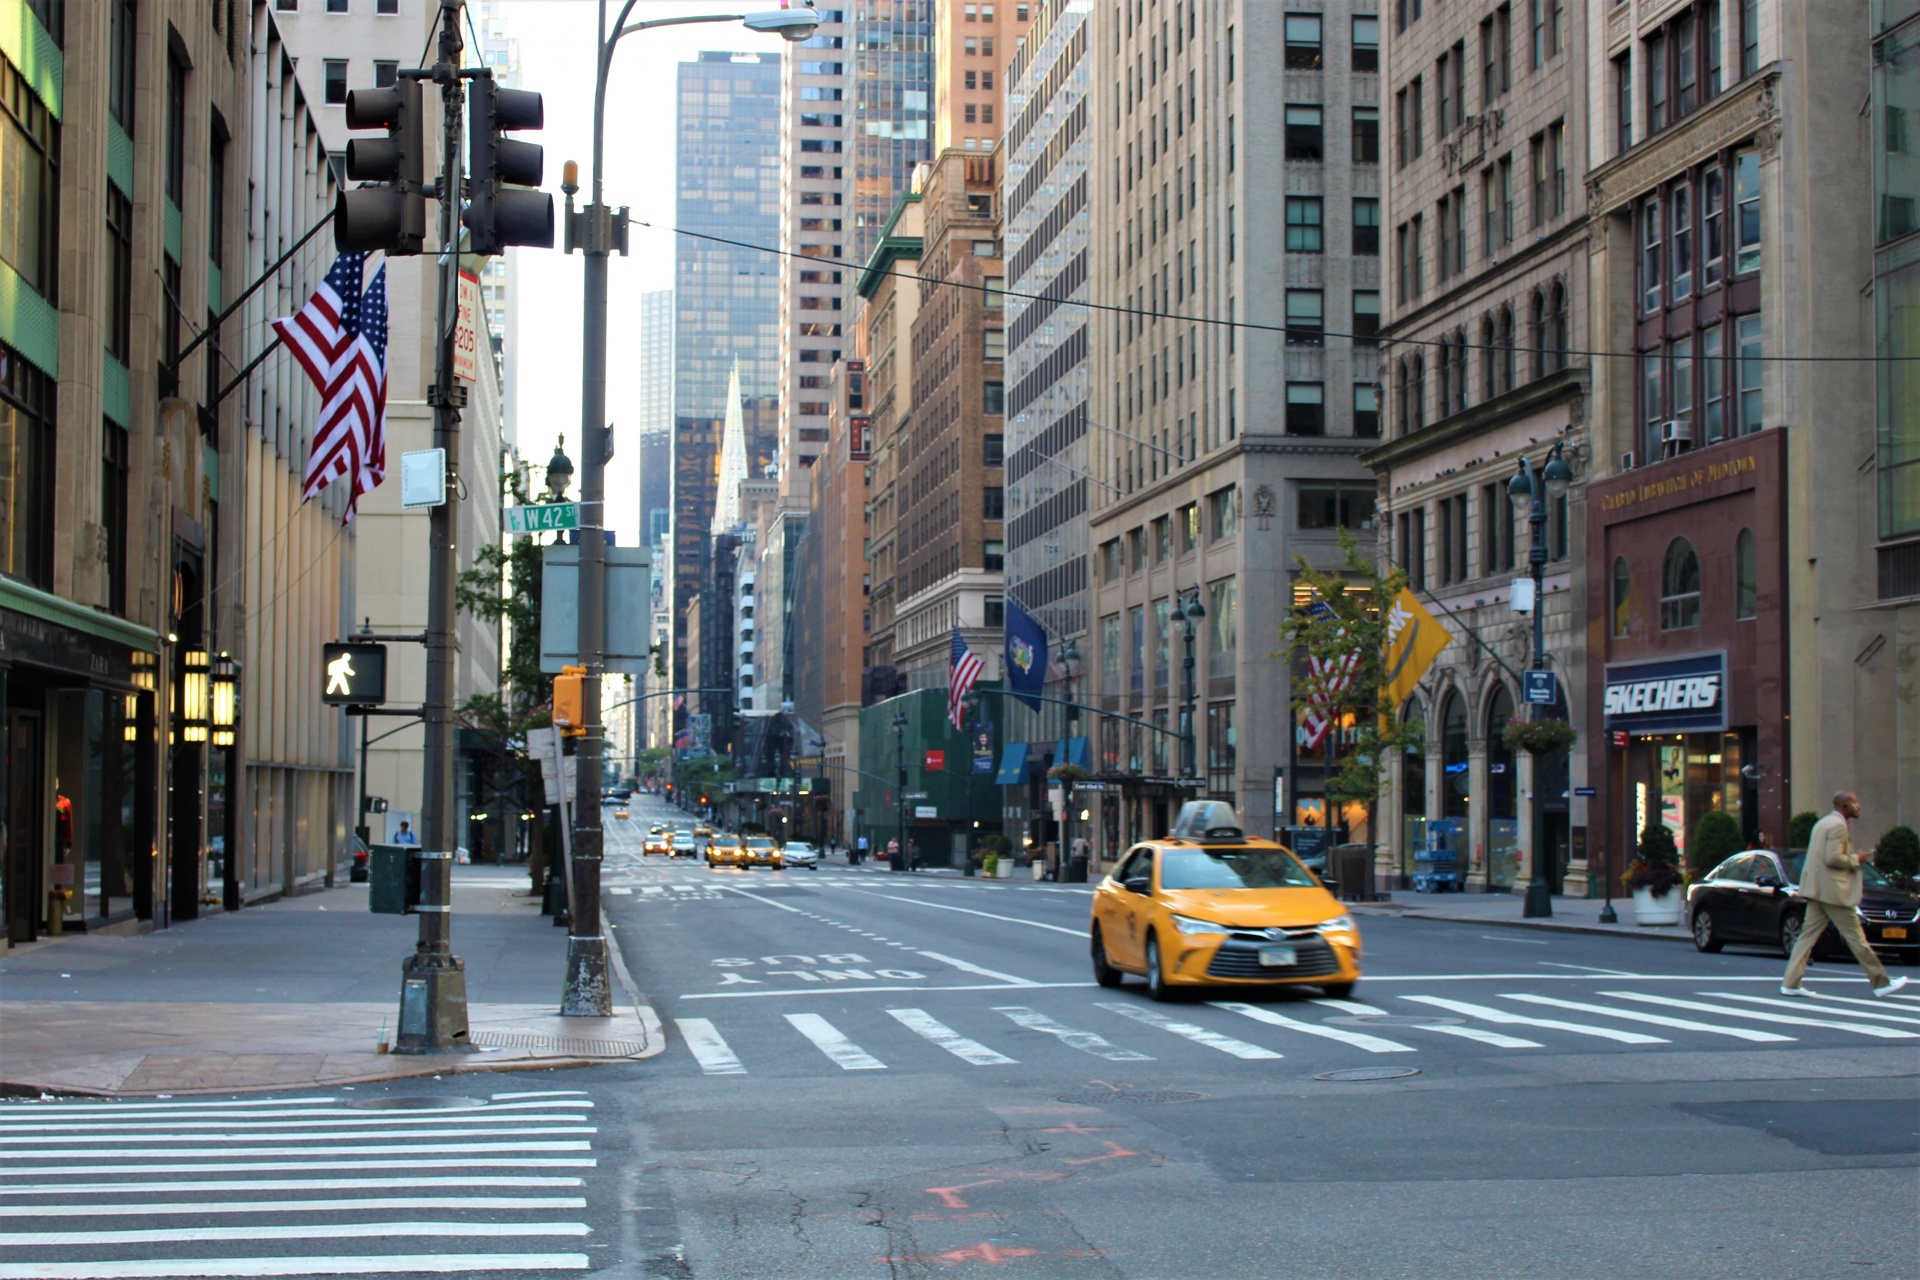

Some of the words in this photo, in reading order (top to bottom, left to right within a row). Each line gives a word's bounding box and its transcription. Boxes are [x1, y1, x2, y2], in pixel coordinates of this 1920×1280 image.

[1709, 455, 1756, 482] MIDTOWN
[526, 509, 539, 529] W
[542, 506, 564, 528] 42
[565, 506, 575, 517] ST
[1604, 675, 1719, 714] SKECHERS
[717, 969, 927, 985] ONLY
